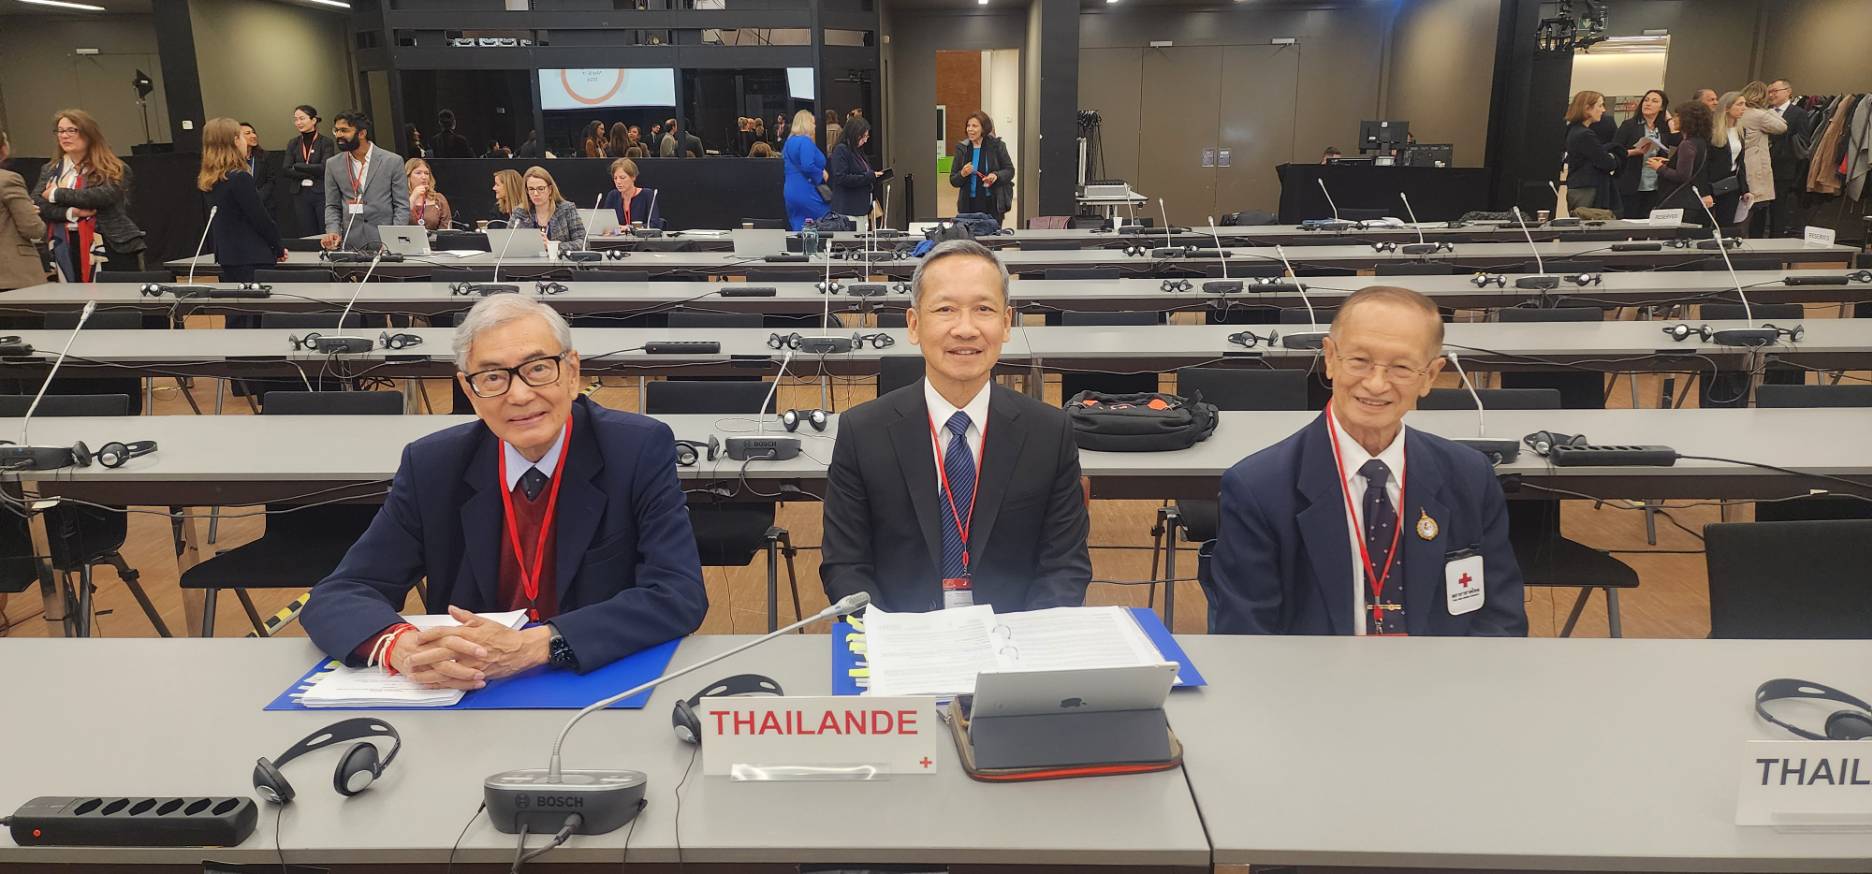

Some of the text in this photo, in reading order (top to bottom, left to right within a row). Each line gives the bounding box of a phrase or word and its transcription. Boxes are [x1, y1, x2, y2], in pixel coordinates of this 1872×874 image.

[709, 710, 918, 735] THAILANDE
[1756, 758, 1872, 785] THAIL
[536, 795, 584, 808] BOSCH
